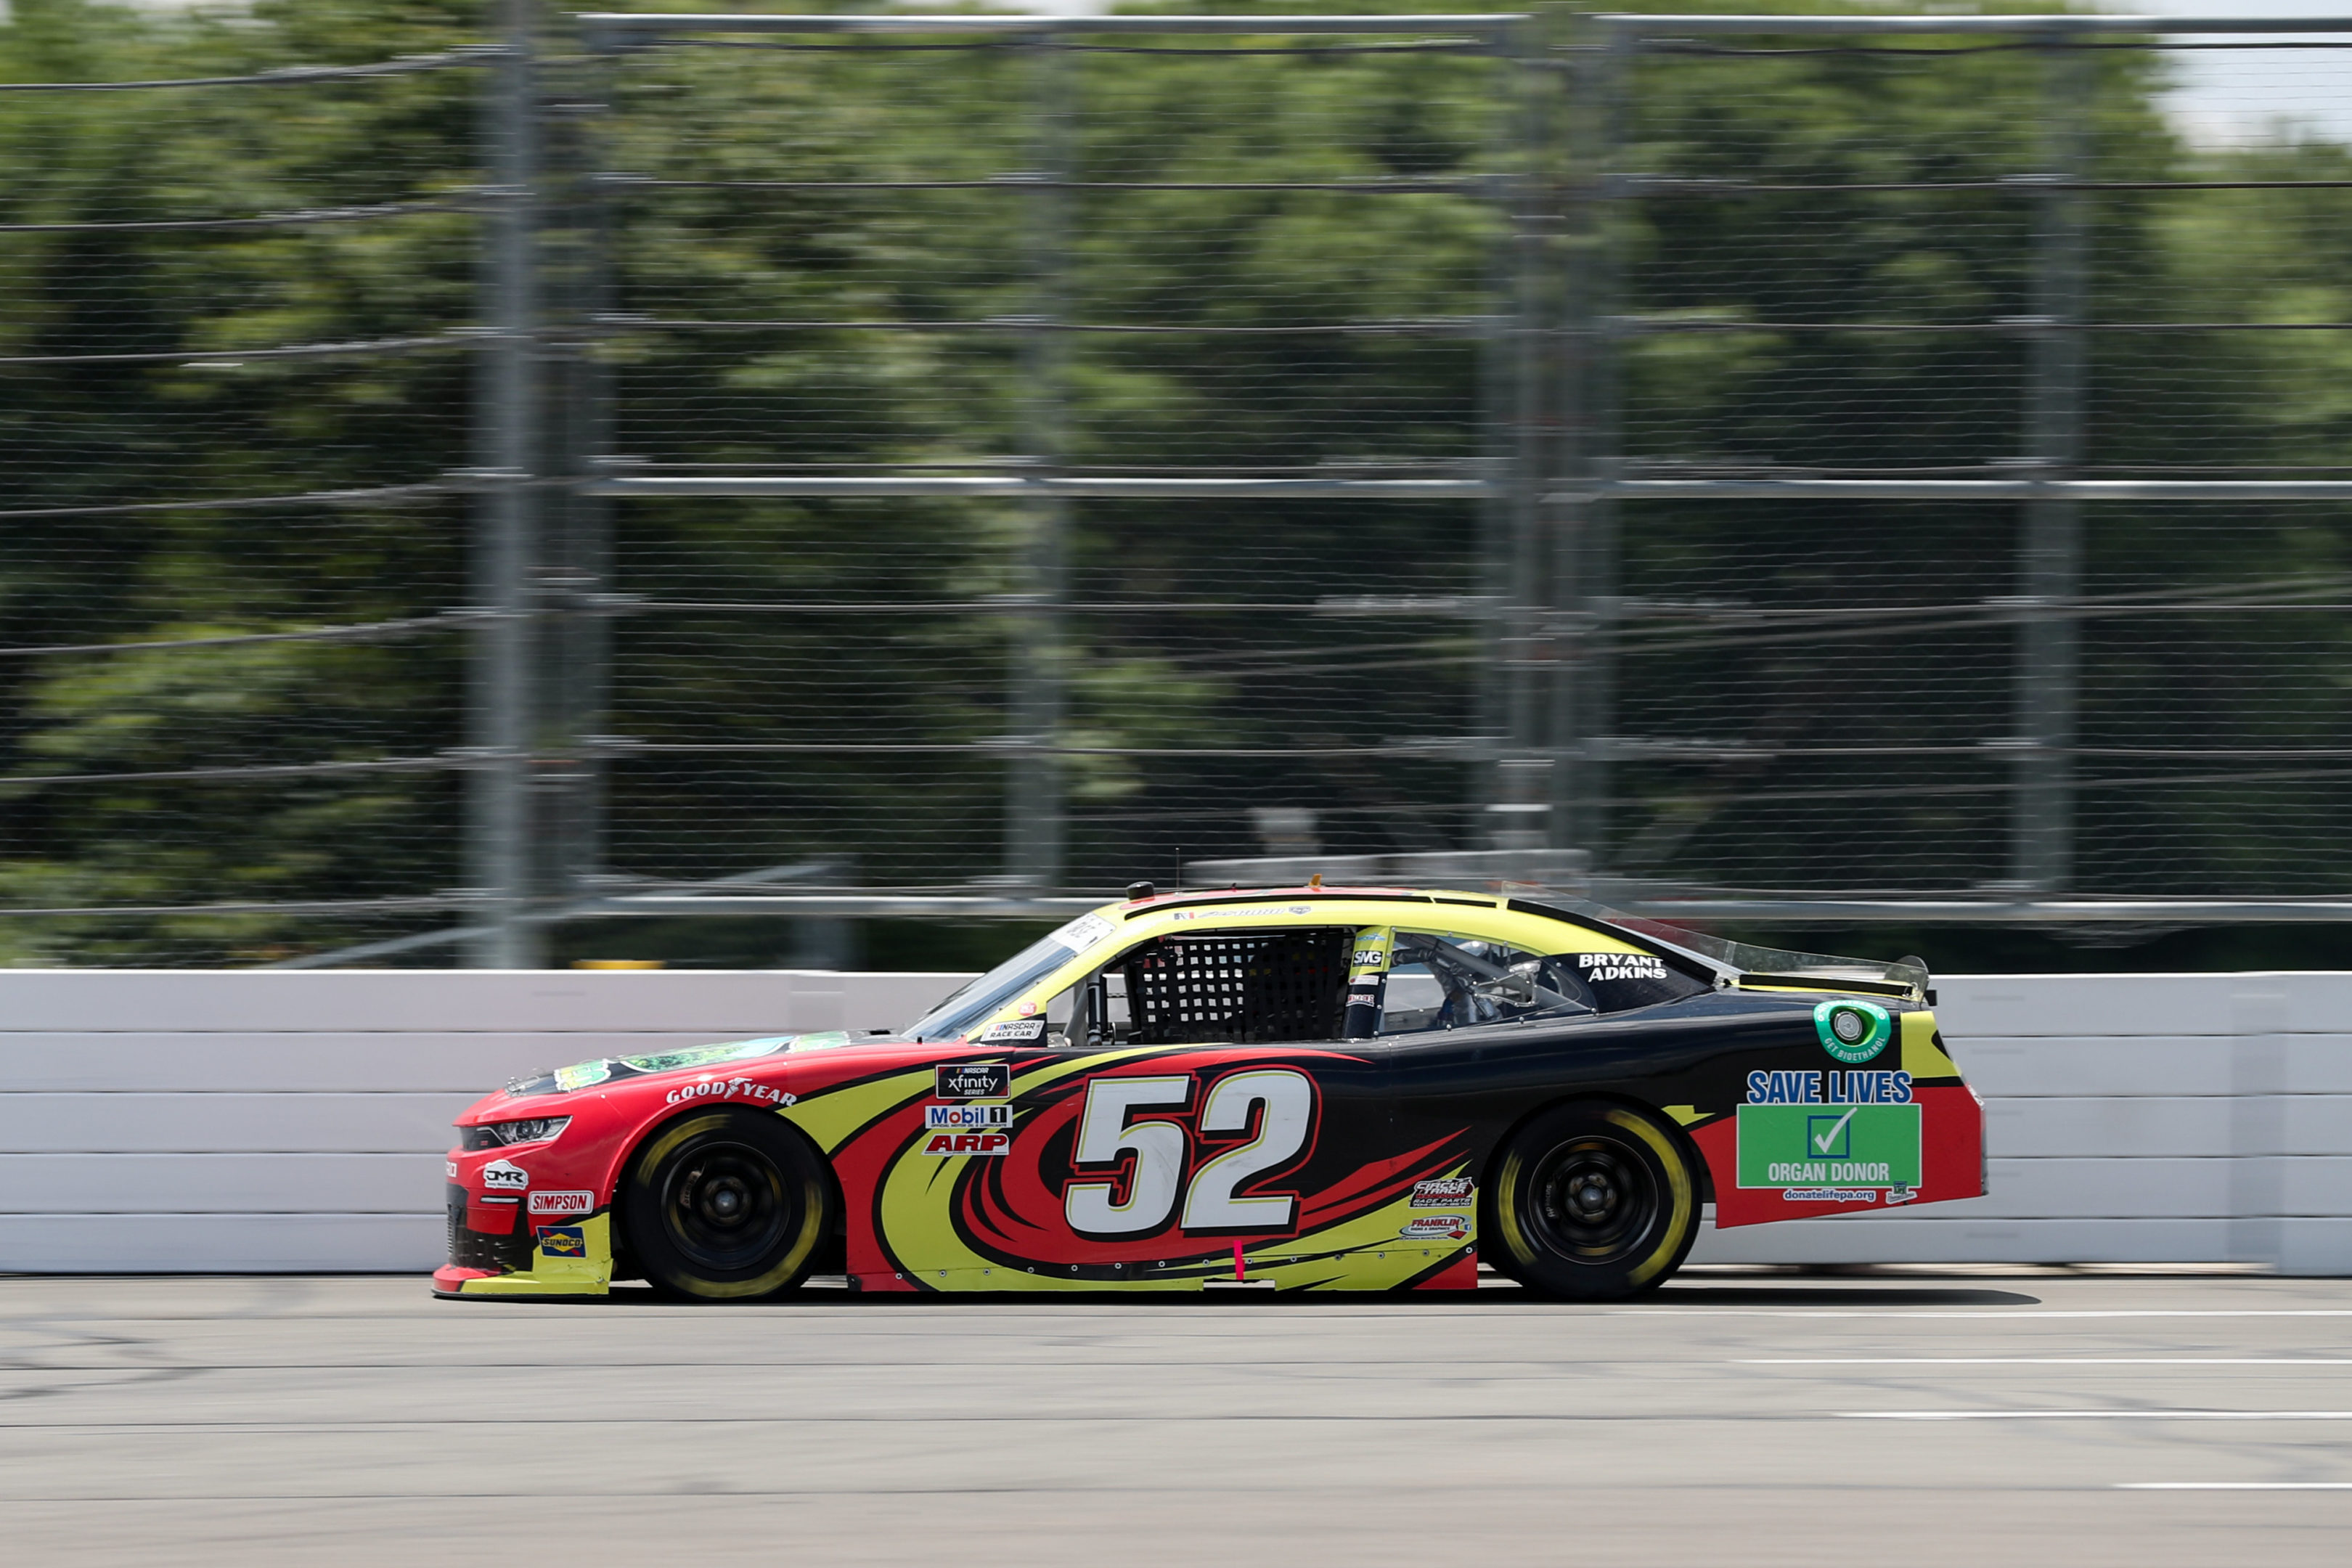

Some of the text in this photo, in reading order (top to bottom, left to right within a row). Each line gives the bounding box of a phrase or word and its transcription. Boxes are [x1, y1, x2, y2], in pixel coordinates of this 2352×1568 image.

[1353, 951, 1382, 964] SMG
[1579, 954, 1663, 968] BRYANT
[1588, 966, 1667, 982] ADKINS
[1824, 1037, 1886, 1061] GET BIOETHANOL
[948, 1074, 998, 1092] xfinity
[1748, 1071, 1912, 1103] SAVE LIVES
[931, 1107, 984, 1124] Mobil
[925, 1135, 1008, 1152] ARP
[1065, 1069, 1312, 1233] 52
[486, 1170, 523, 1183] JMR
[1768, 1163, 1890, 1182] ORGAN DONOR
[533, 1195, 587, 1210] SIMPSON
[1785, 1190, 1874, 1201] donatelifepa.org
[543, 1238, 581, 1247] SUNOCO
